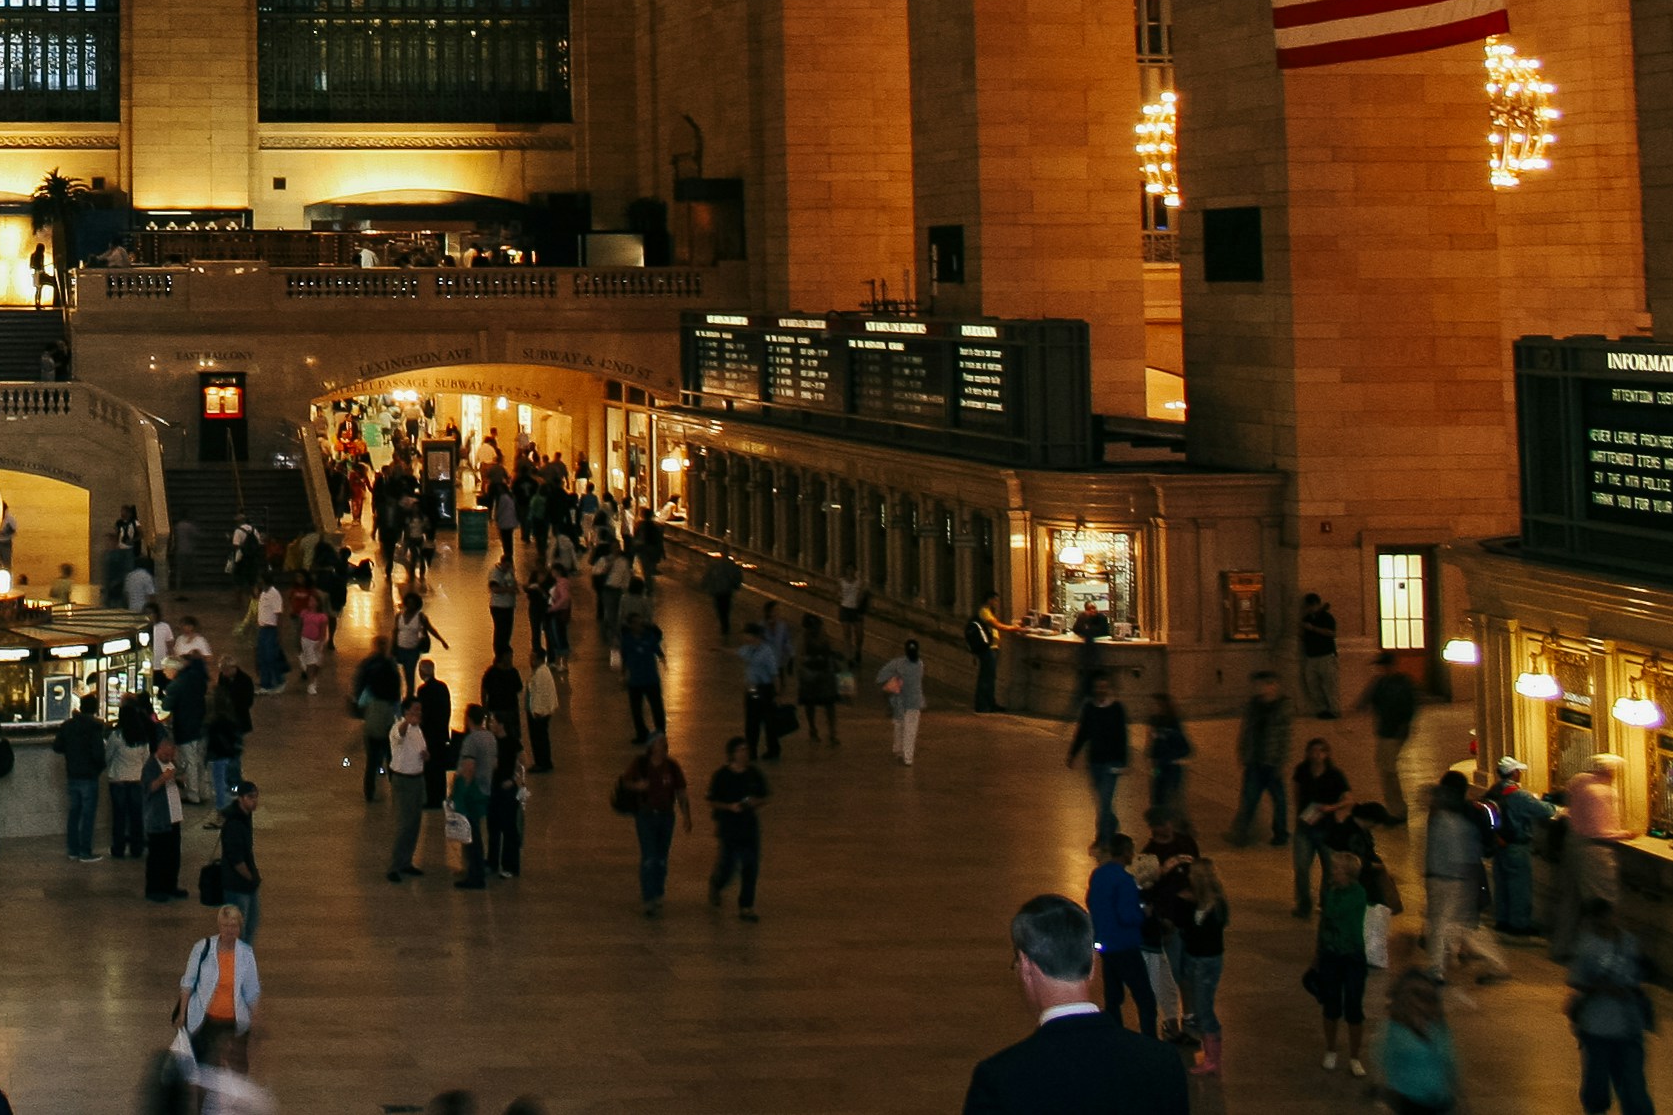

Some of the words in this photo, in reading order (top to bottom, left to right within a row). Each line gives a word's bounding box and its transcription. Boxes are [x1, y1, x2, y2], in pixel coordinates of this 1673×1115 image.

[176, 351, 200, 360] EAST
[204, 351, 254, 360] BALCONY
[359, 352, 442, 376] LEXINGTON
[447, 348, 472, 362] AVE
[522, 348, 580, 363] SUBWAY
[583, 355, 594, 367] &
[599, 357, 634, 374] 42ND
[637, 366, 654, 380] ST
[379, 379, 428, 389] PASSAGE
[435, 378, 484, 391] SUBWAY
[1612, 388, 1654, 404] ATTENTION
[1614, 430, 1637, 445] LEAVE
[1637, 454, 1661, 470] ITEMS
[1594, 471, 1604, 484] BY
[1607, 472, 1622, 486] THE
[1642, 476, 1672, 493] POLICE
[1617, 494, 1632, 509] YOU
[1634, 496, 1650, 511] FOR
[1653, 499, 1673, 515] YOUR
